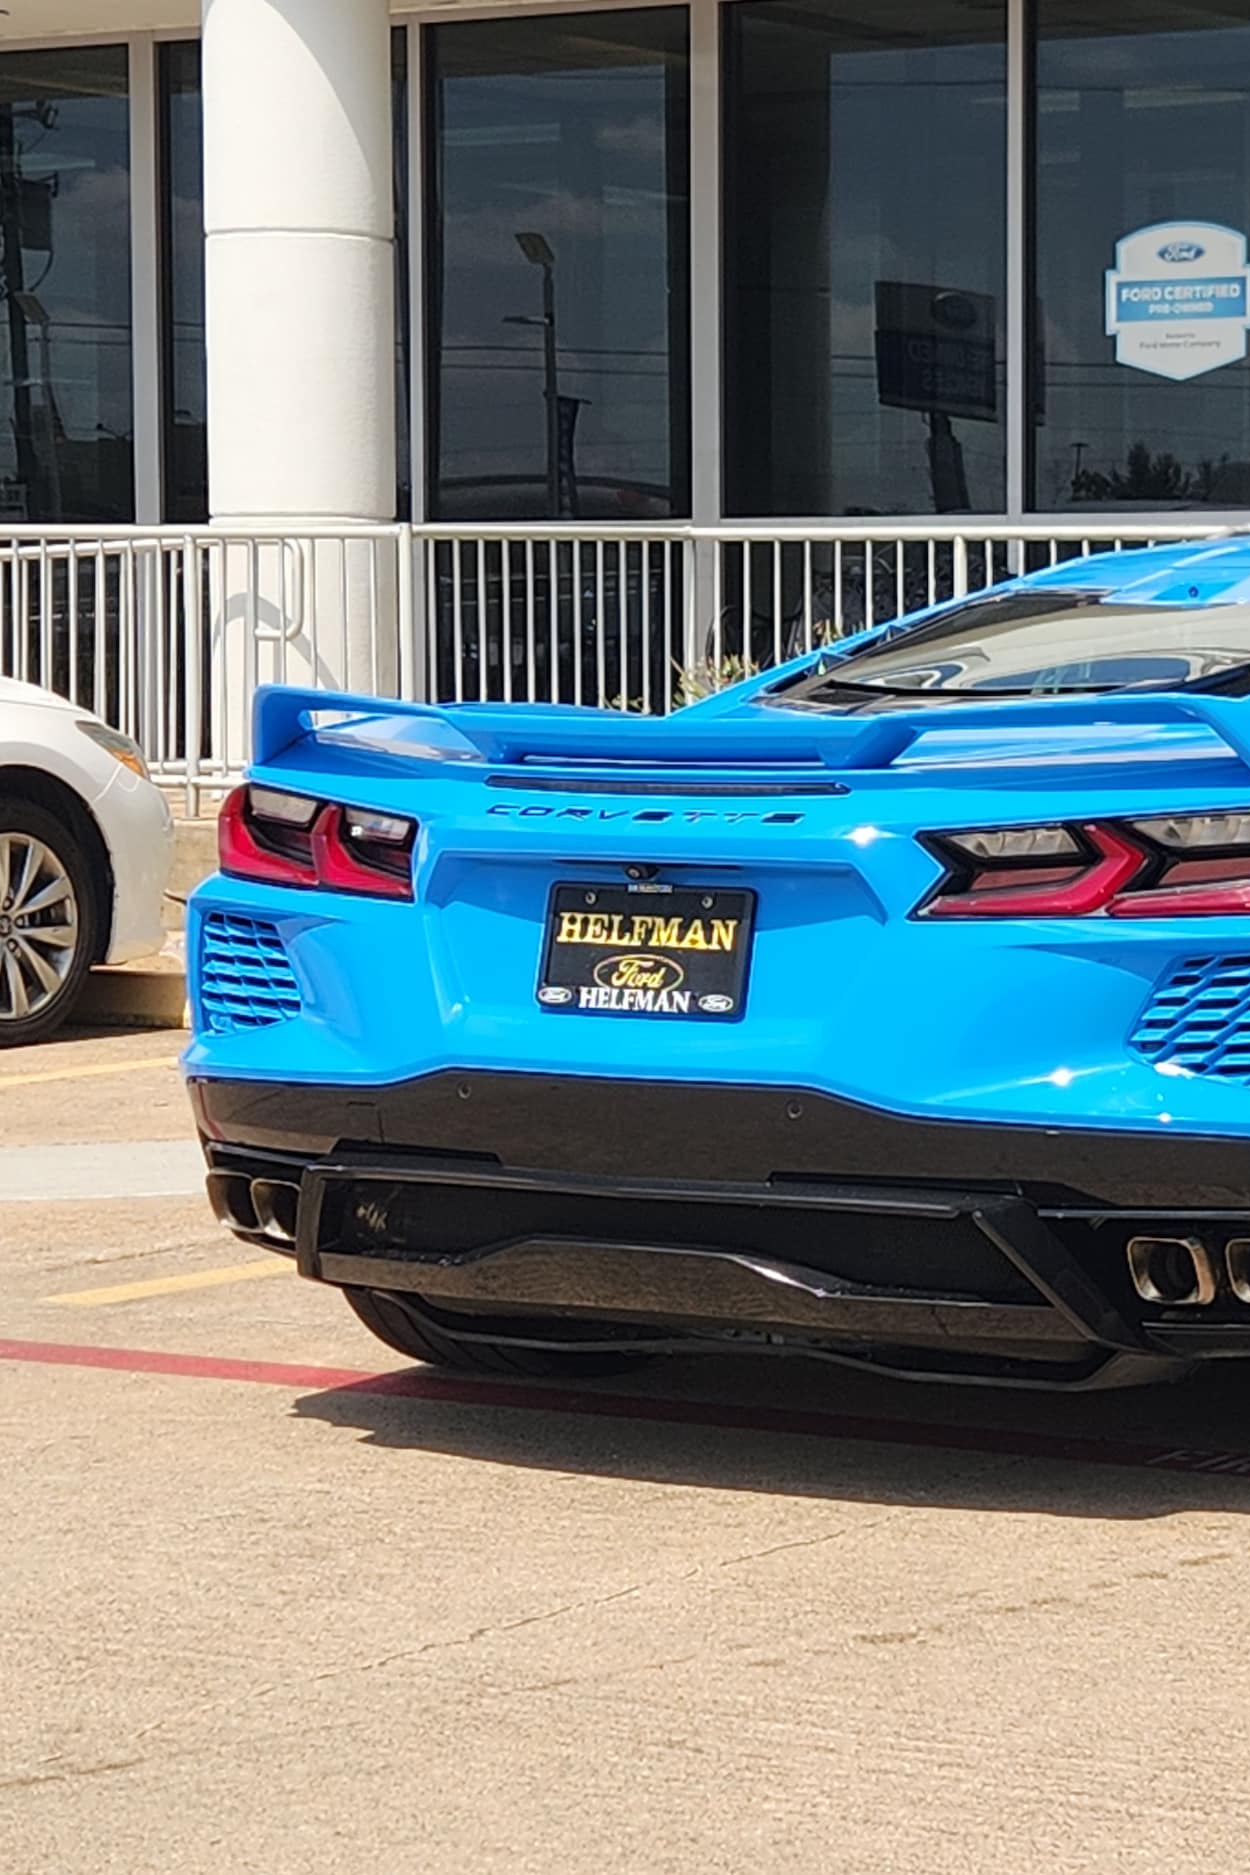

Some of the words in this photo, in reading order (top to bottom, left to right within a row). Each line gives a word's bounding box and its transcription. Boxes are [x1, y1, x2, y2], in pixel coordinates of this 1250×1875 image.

[1121, 287, 1161, 302] FORD
[1164, 284, 1240, 300] CERTIFIED
[485, 803, 807, 823] CORVETTE
[556, 912, 738, 951] HELFMAN
[610, 958, 667, 988] Ford
[578, 986, 692, 1013] HELFMAN
